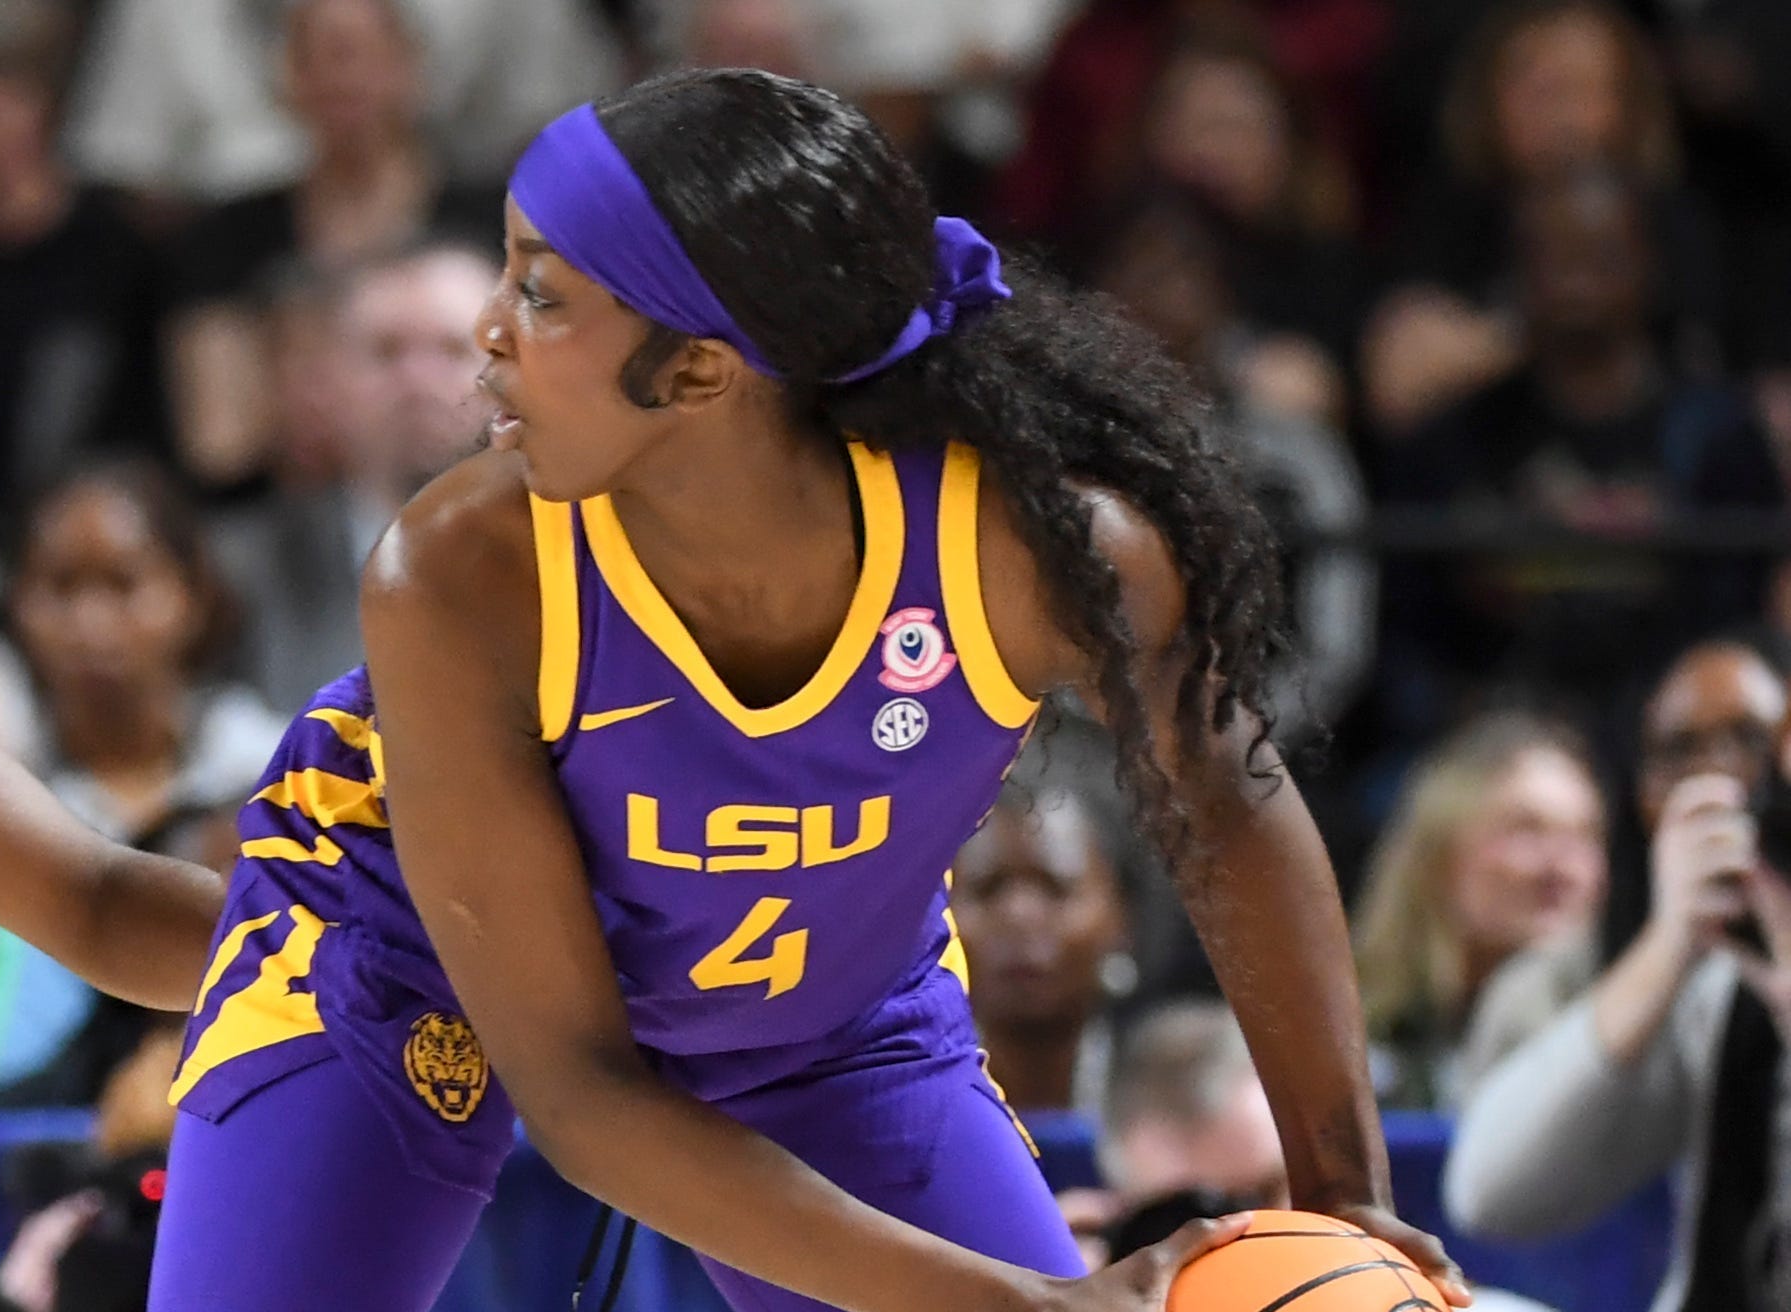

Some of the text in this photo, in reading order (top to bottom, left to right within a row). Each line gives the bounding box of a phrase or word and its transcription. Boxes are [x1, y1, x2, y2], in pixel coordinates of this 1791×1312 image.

[876, 701, 925, 749] SEC
[627, 793, 891, 872] LSU
[688, 897, 808, 1000] 4
